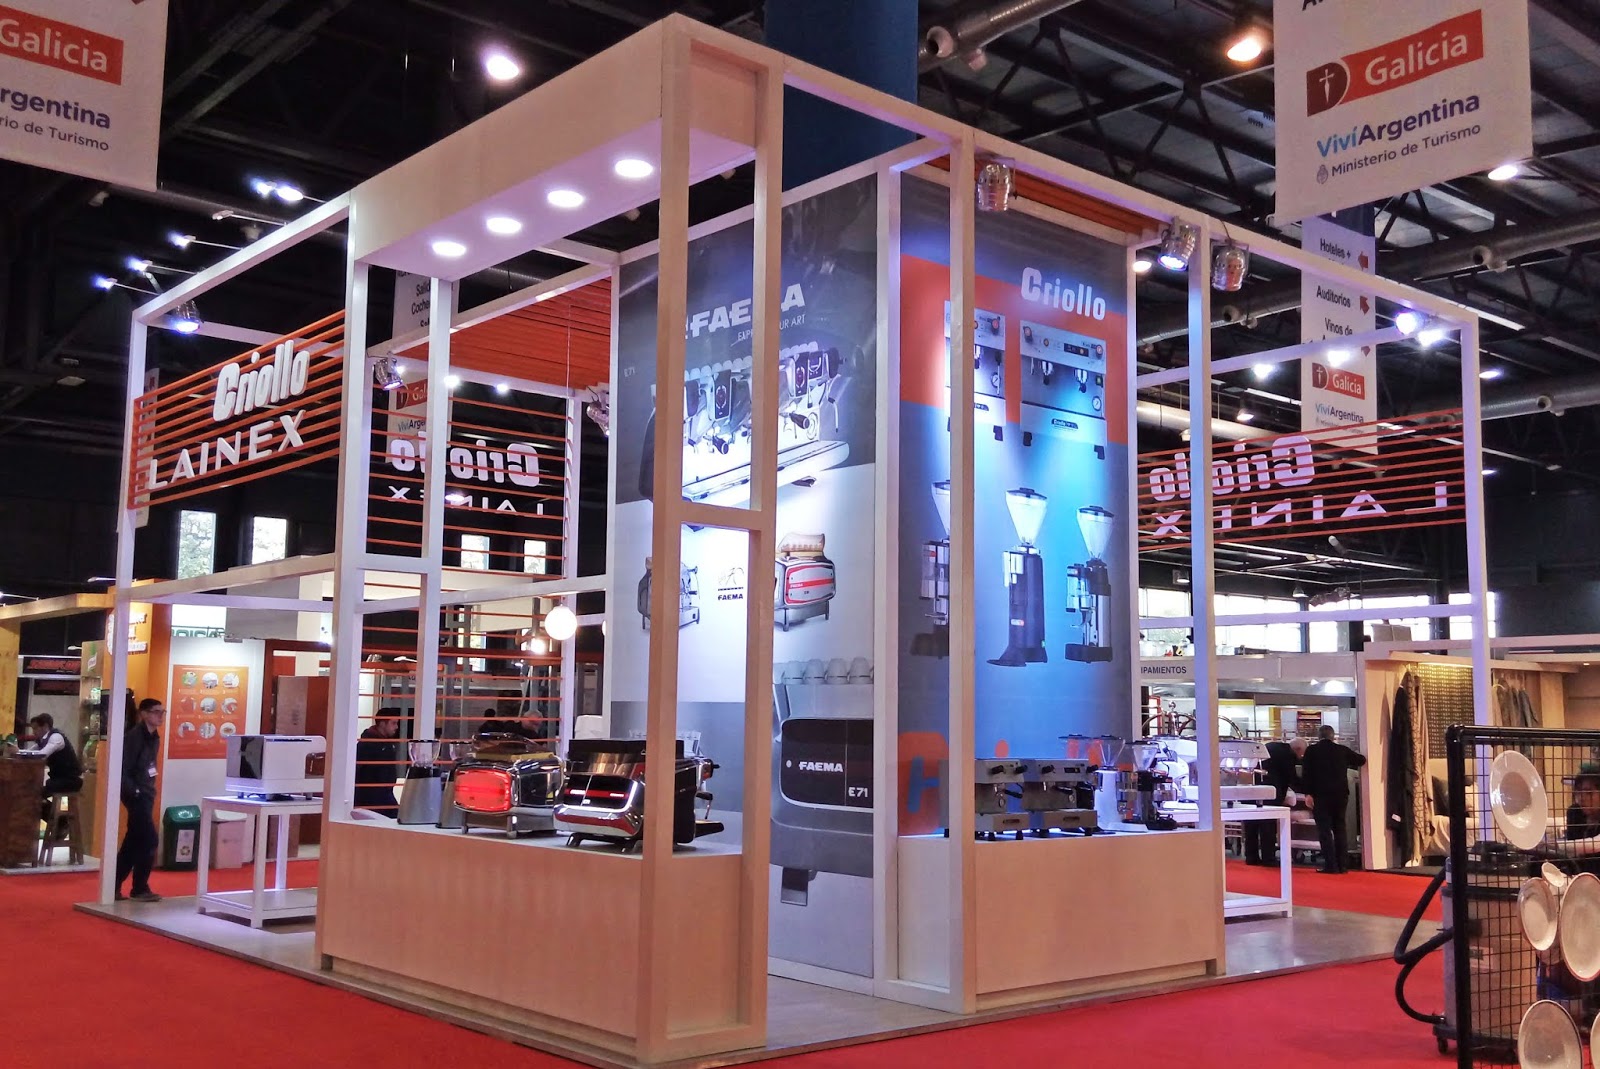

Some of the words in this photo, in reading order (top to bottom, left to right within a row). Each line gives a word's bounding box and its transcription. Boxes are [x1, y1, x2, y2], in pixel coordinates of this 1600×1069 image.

[0, 18, 108, 73] Galicia
[1365, 30, 1469, 86] Galicia
[0, 87, 111, 129] rgentina
[24, 121, 44, 135] de
[49, 126, 109, 151] Turismo
[1331, 150, 1397, 177] Ministerio
[1401, 143, 1418, 156] de
[1422, 124, 1481, 149] Turismo
[1320, 238, 1345, 259] Hoteles
[1020, 266, 1106, 321] Criollo
[1316, 285, 1351, 308] Auditorios
[690, 283, 806, 338] FAEA
[791, 314, 806, 326] ART
[1324, 317, 1343, 335] Vinos
[1344, 325, 1353, 336] de
[212, 340, 311, 422] Criollo
[1332, 374, 1362, 395] Galicia
[148, 409, 307, 490] LAINEX
[718, 593, 744, 601] FAEMA
[1140, 666, 1187, 674] IPAMIENTOS
[798, 761, 844, 773] FAEMA
[848, 786, 869, 798] E71
